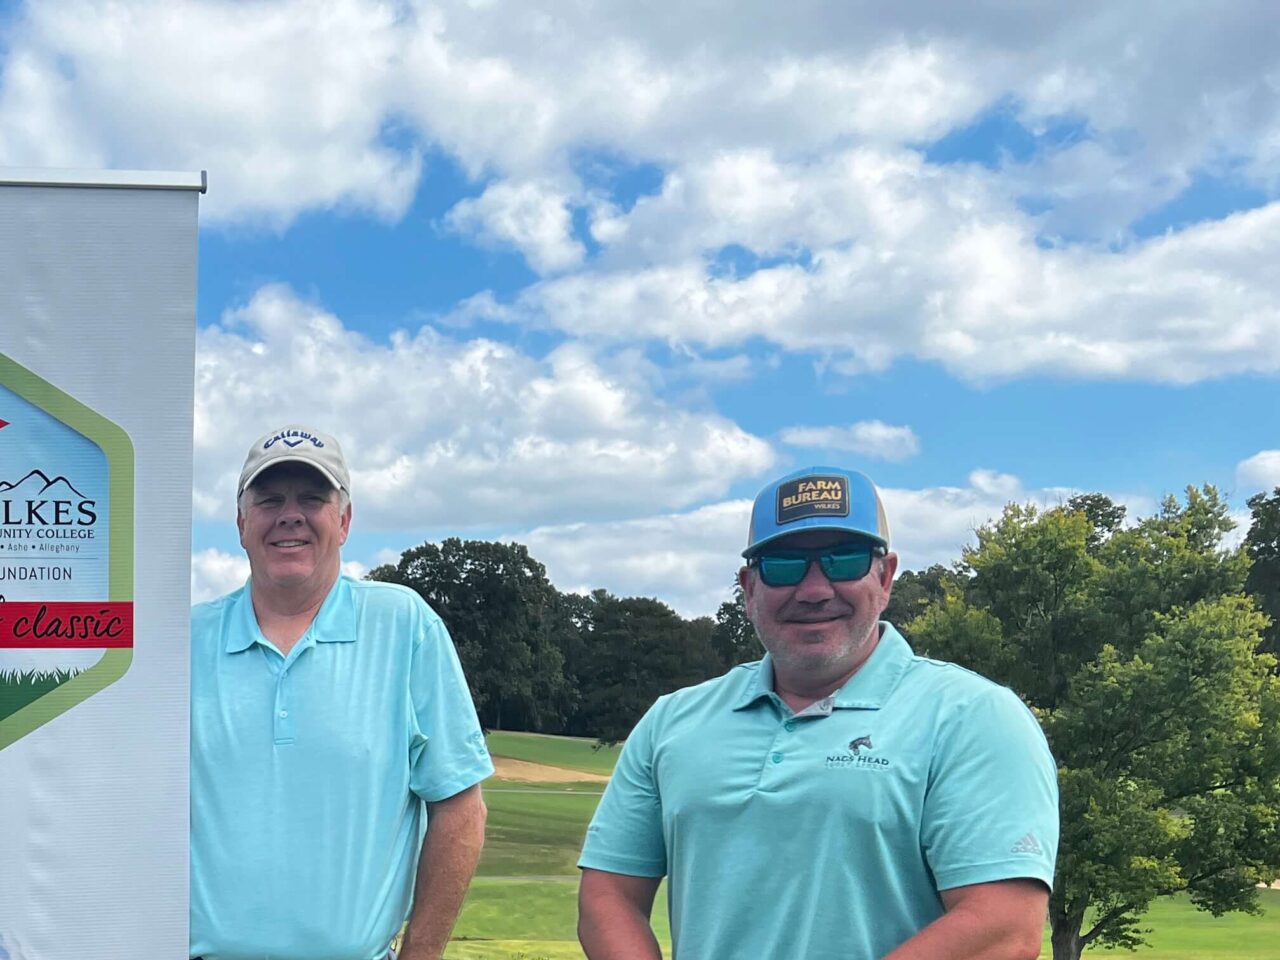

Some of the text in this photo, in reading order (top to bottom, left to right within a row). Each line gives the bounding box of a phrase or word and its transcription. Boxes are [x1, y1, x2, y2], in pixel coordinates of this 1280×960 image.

[263, 429, 324, 449] Callaway
[798, 480, 841, 493] FARM
[783, 490, 842, 508] BUREAU
[36, 529, 95, 539] COLLEGE
[39, 543, 80, 553] Alleghany
[13, 605, 124, 639] classic
[857, 755, 889, 766] HEAD
